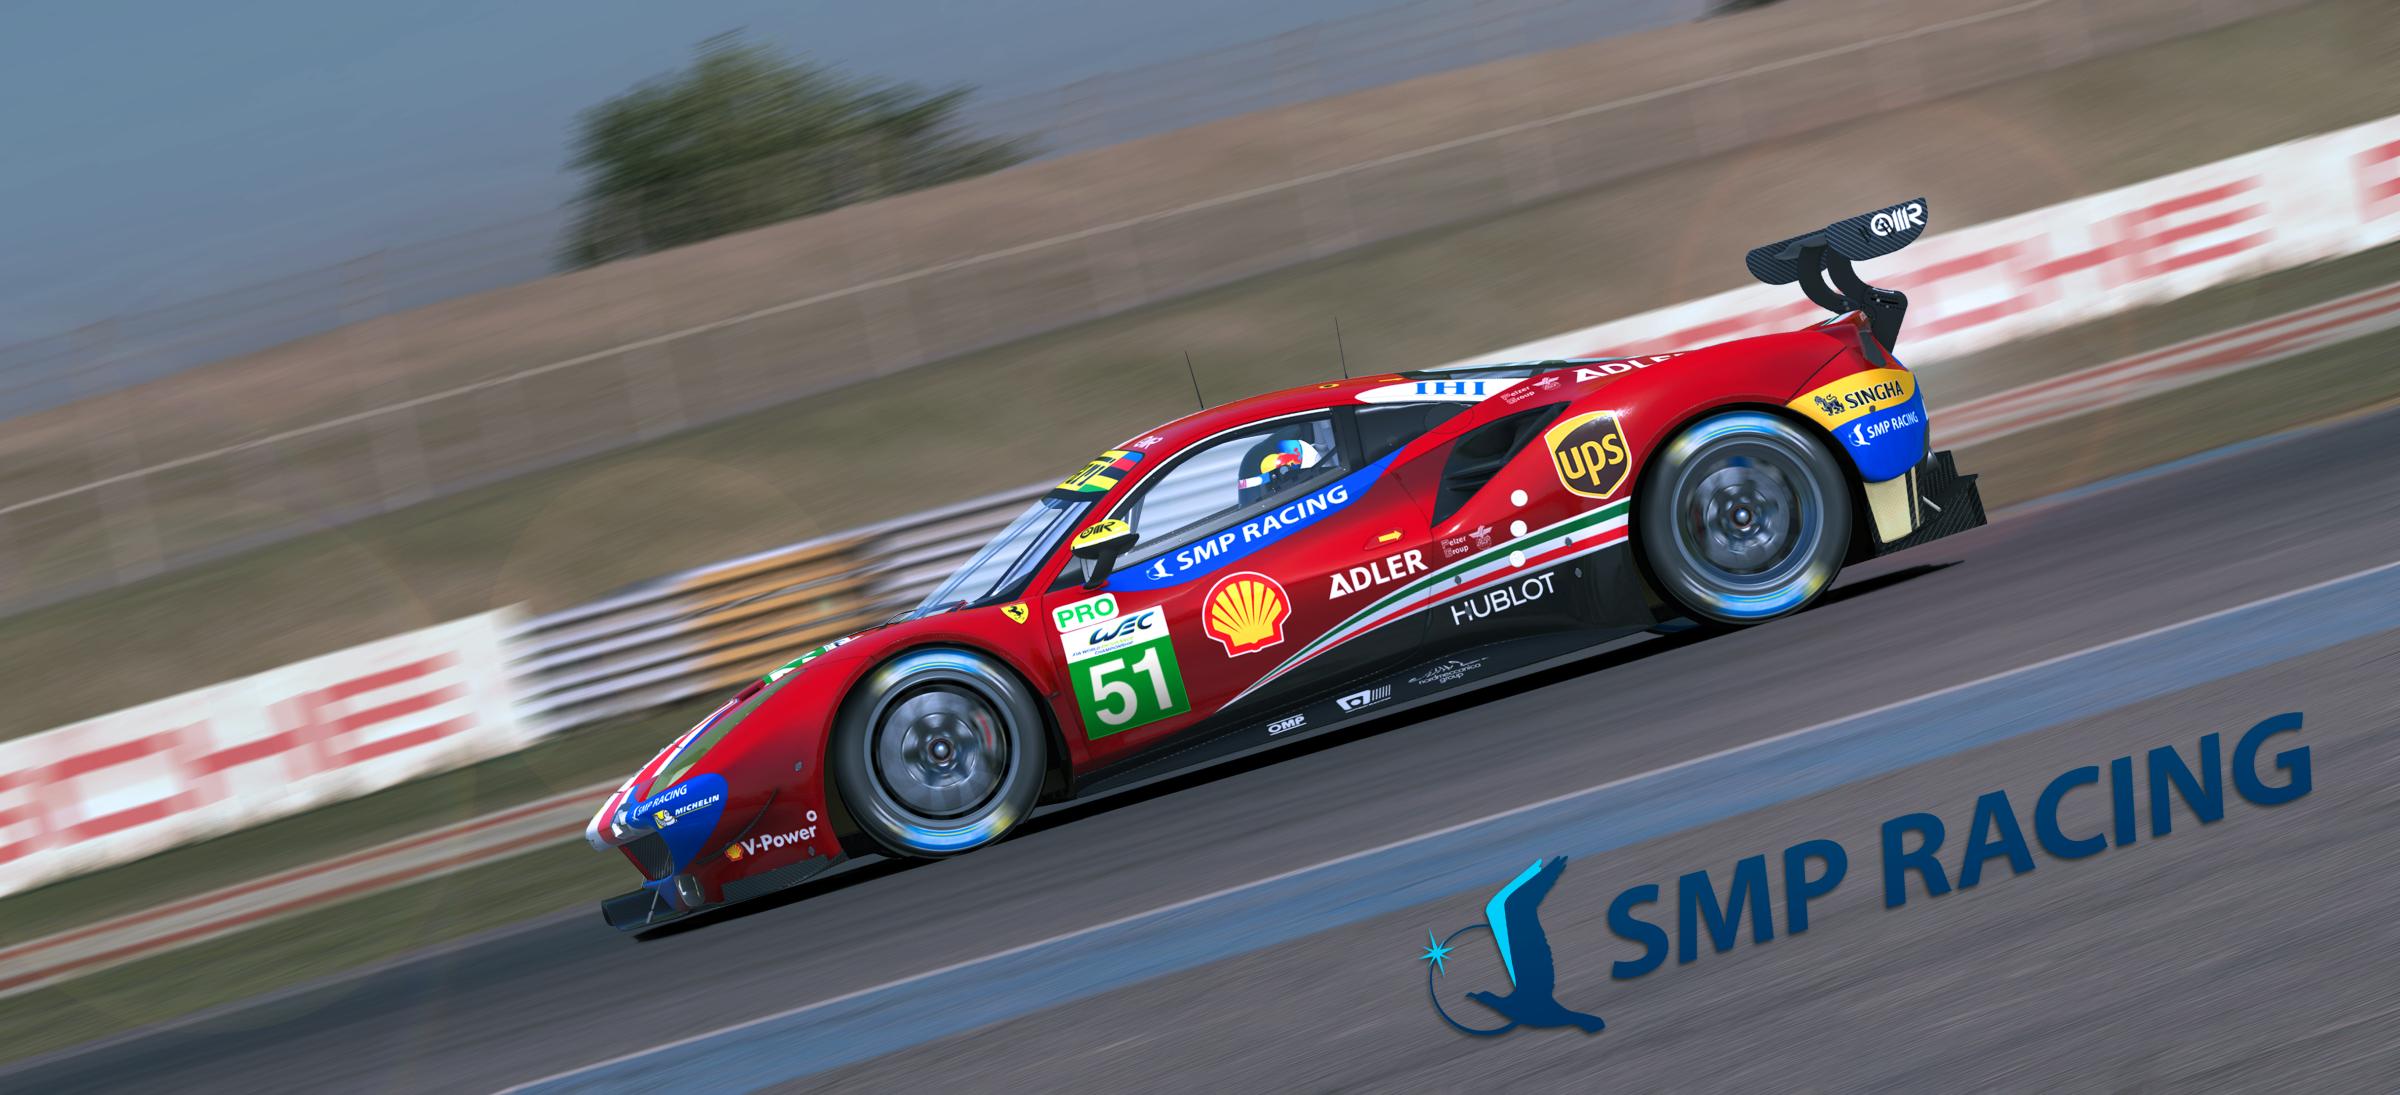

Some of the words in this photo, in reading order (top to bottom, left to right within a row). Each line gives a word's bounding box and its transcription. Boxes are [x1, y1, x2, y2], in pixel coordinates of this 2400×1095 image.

[1415, 381, 1486, 396] IHI
[1844, 380, 1904, 409] SINGHA
[1866, 420, 1890, 439] SMP
[1890, 411, 1919, 430] RACING
[1559, 433, 1625, 486] ups
[1176, 532, 1236, 571] SMP
[1241, 485, 1349, 543] RACING
[1329, 549, 1429, 600] ADLER
[1056, 597, 1115, 629] PRO
[1450, 572, 1555, 626] HUBLOT
[1089, 611, 1154, 645] WEC
[1088, 646, 1173, 725] 51
[1267, 715, 1305, 733] OMP
[652, 784, 688, 807] RACING
[674, 793, 720, 816] MICHELIN
[742, 824, 817, 856] V-Power
